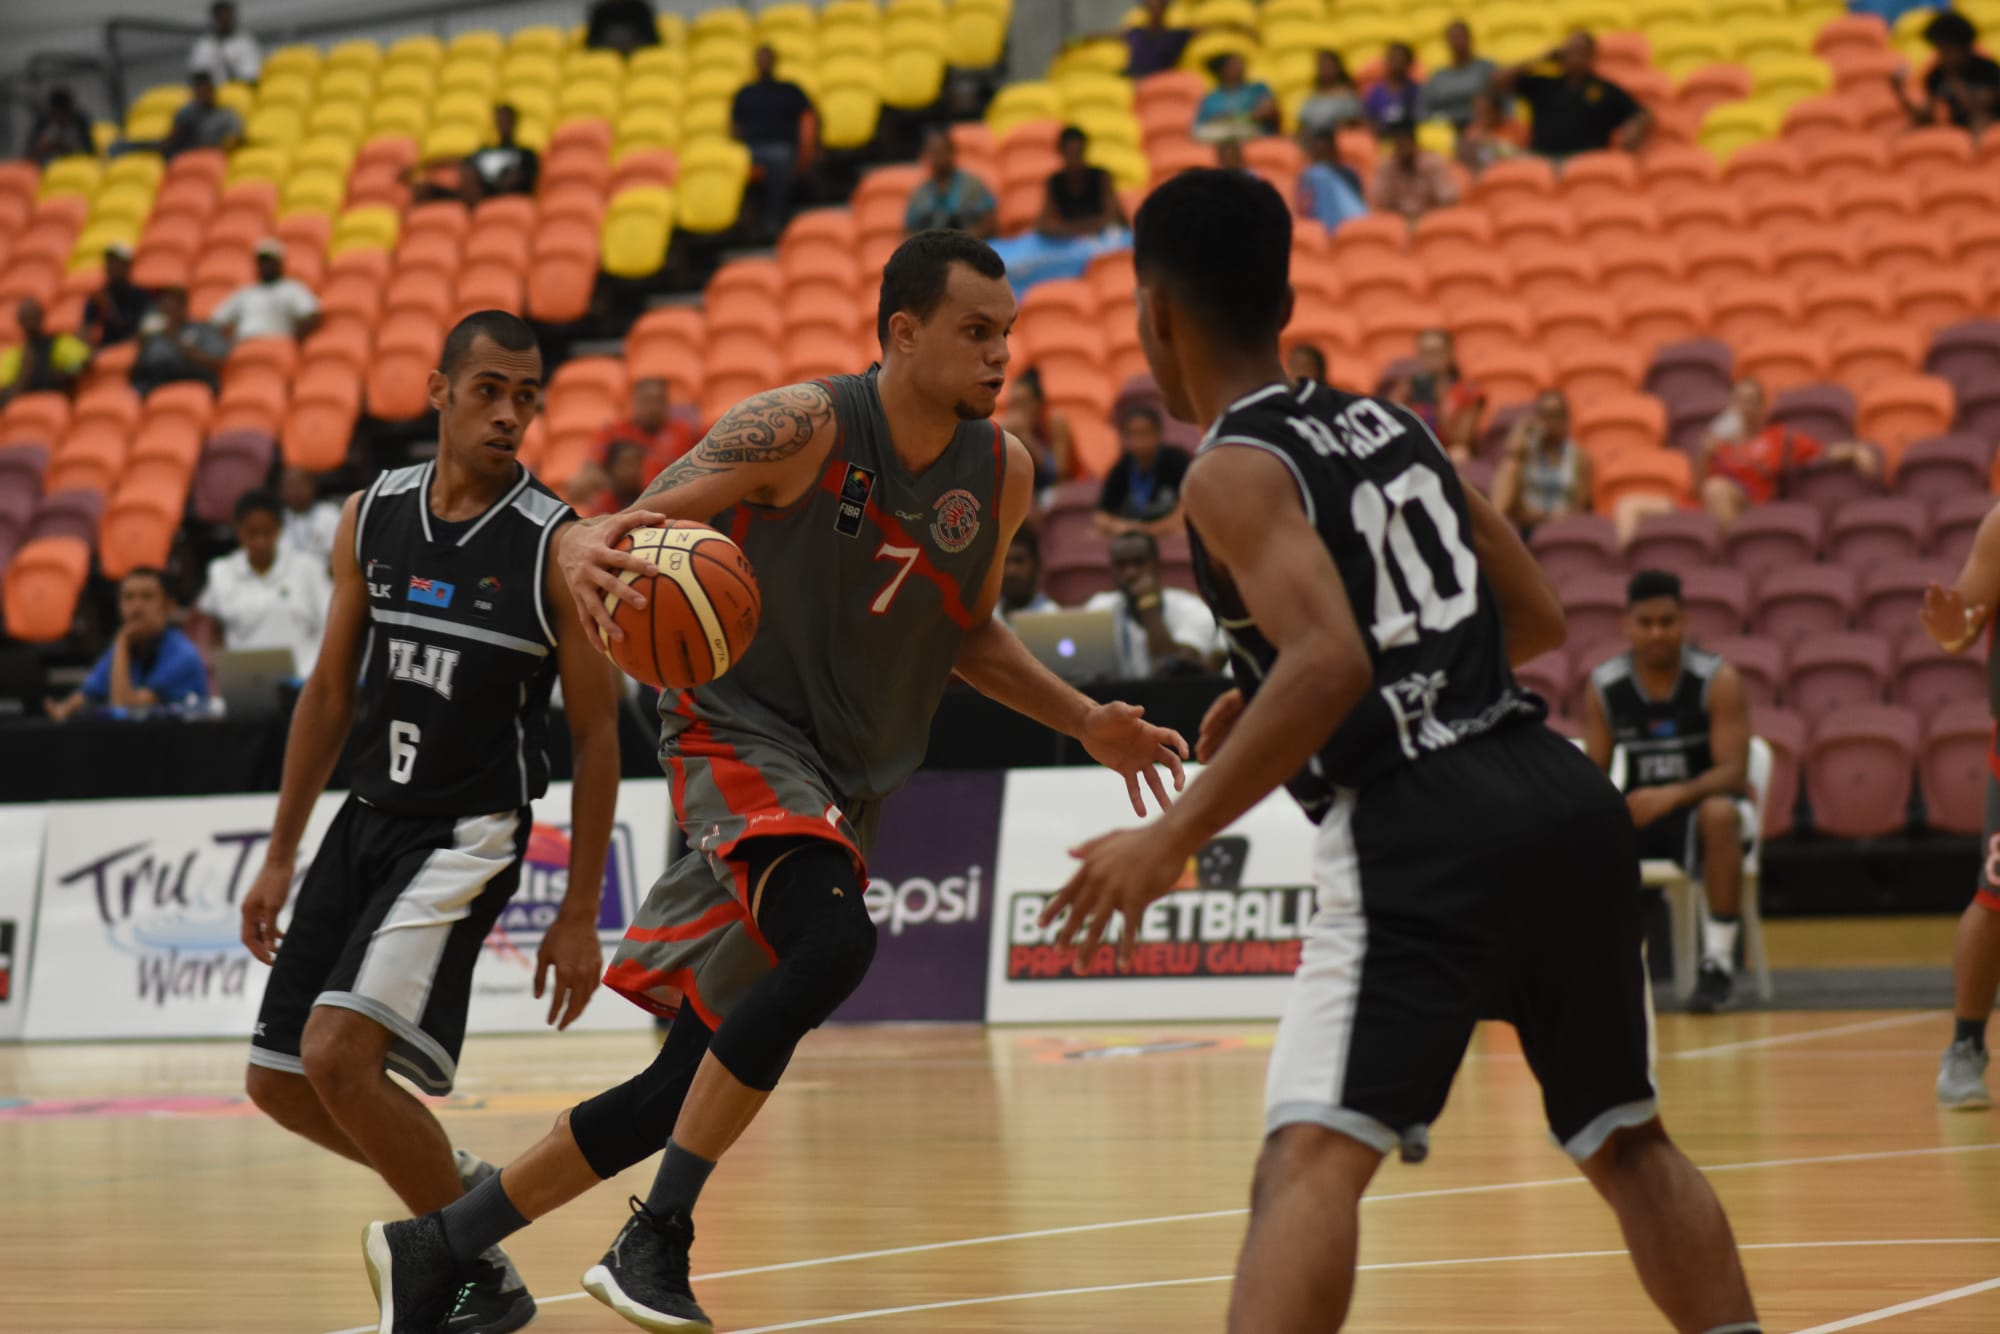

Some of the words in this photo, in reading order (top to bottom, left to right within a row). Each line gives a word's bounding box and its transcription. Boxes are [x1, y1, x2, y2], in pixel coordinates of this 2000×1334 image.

[871, 542, 921, 614] 7
[1351, 463, 1477, 650] 10
[389, 719, 421, 785] 6
[58, 839, 196, 926] Tru
[863, 865, 981, 935] epsi
[138, 947, 250, 1005] Wara
[1009, 944, 1115, 978] PAPA
[1205, 938, 1304, 974] GUINE
